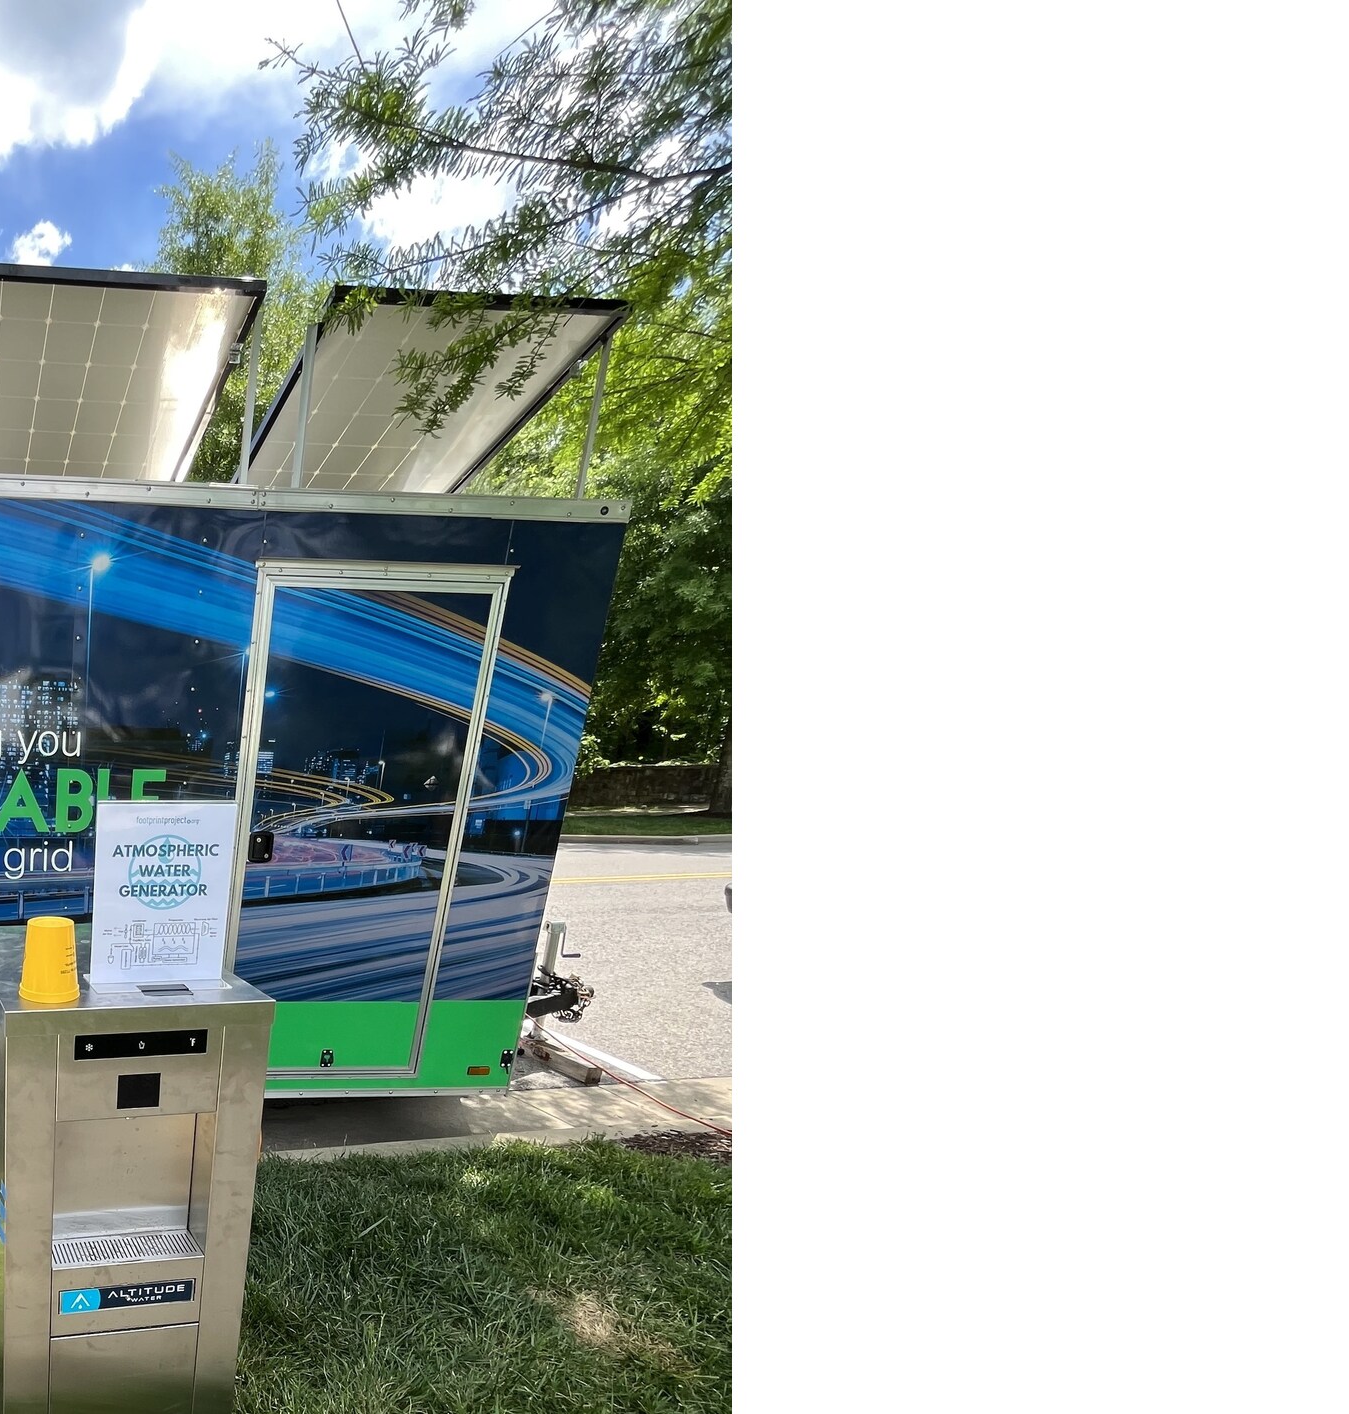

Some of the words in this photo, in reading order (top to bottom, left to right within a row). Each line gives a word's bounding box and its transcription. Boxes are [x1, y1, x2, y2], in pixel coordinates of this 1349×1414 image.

[17, 730, 82, 764] you
[112, 844, 220, 858] ATMOSPHERIC
[3, 840, 74, 878] grid
[138, 864, 191, 878] WATER
[119, 884, 208, 898] GENERATOR
[108, 1284, 185, 1299] ALTITUDE
